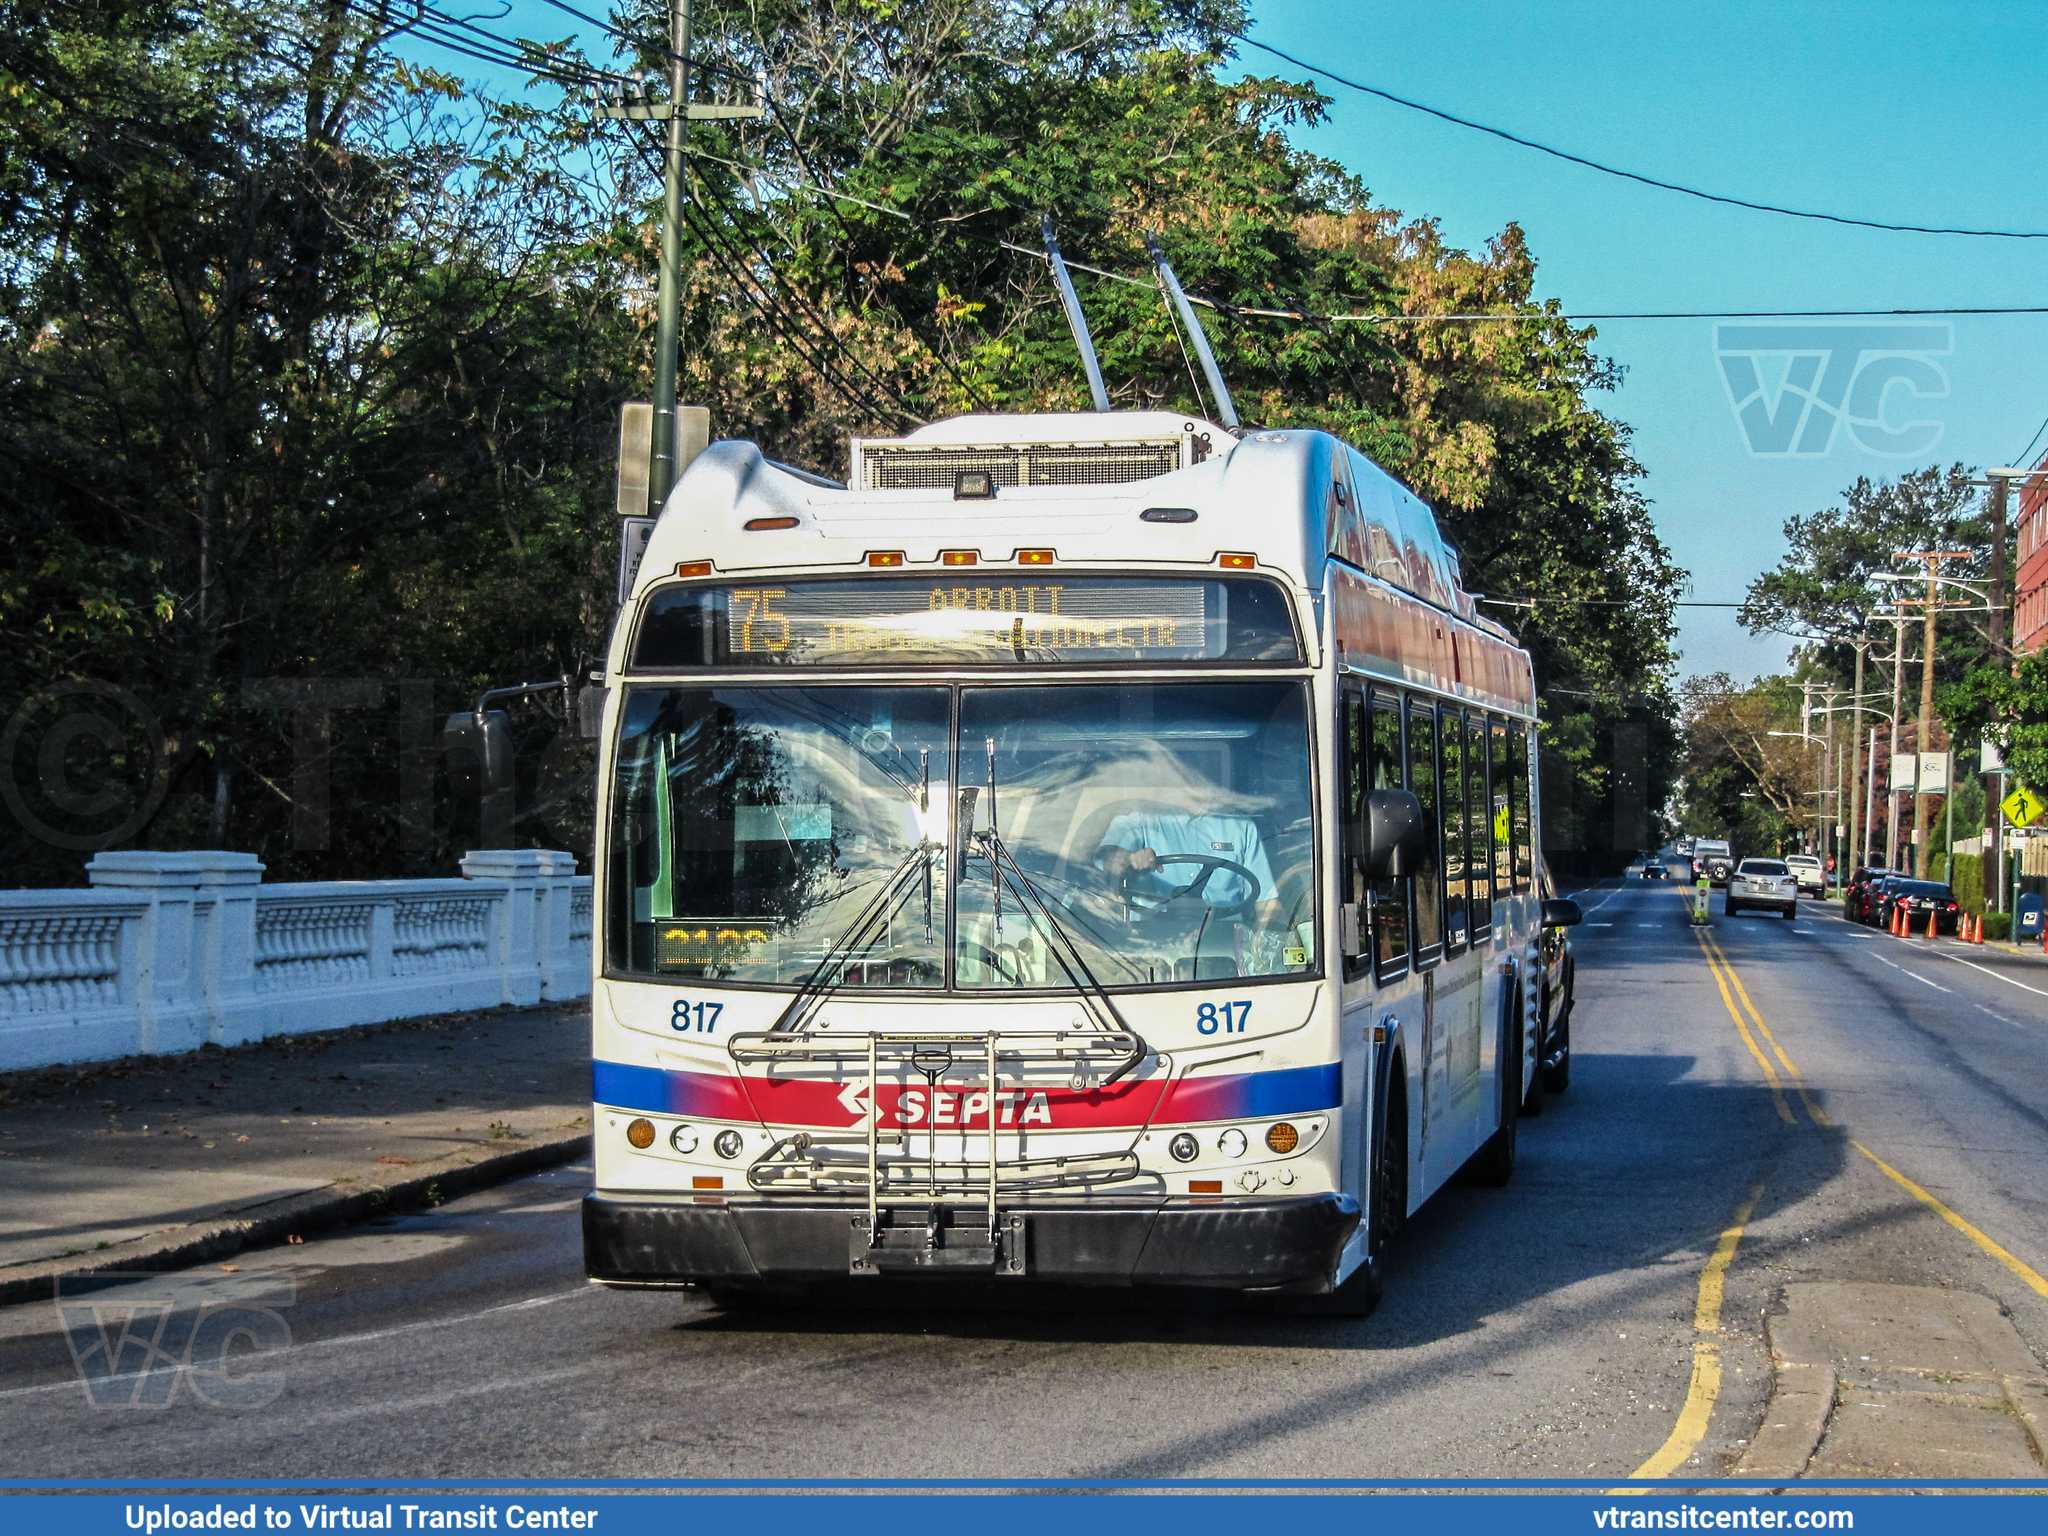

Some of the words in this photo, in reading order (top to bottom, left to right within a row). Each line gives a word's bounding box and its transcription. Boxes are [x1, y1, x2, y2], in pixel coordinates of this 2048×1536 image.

[734, 590, 790, 651] 75
[671, 999, 724, 1034] 817
[1197, 1000, 1252, 1035] 817
[894, 1090, 1052, 1124] SEPTA
